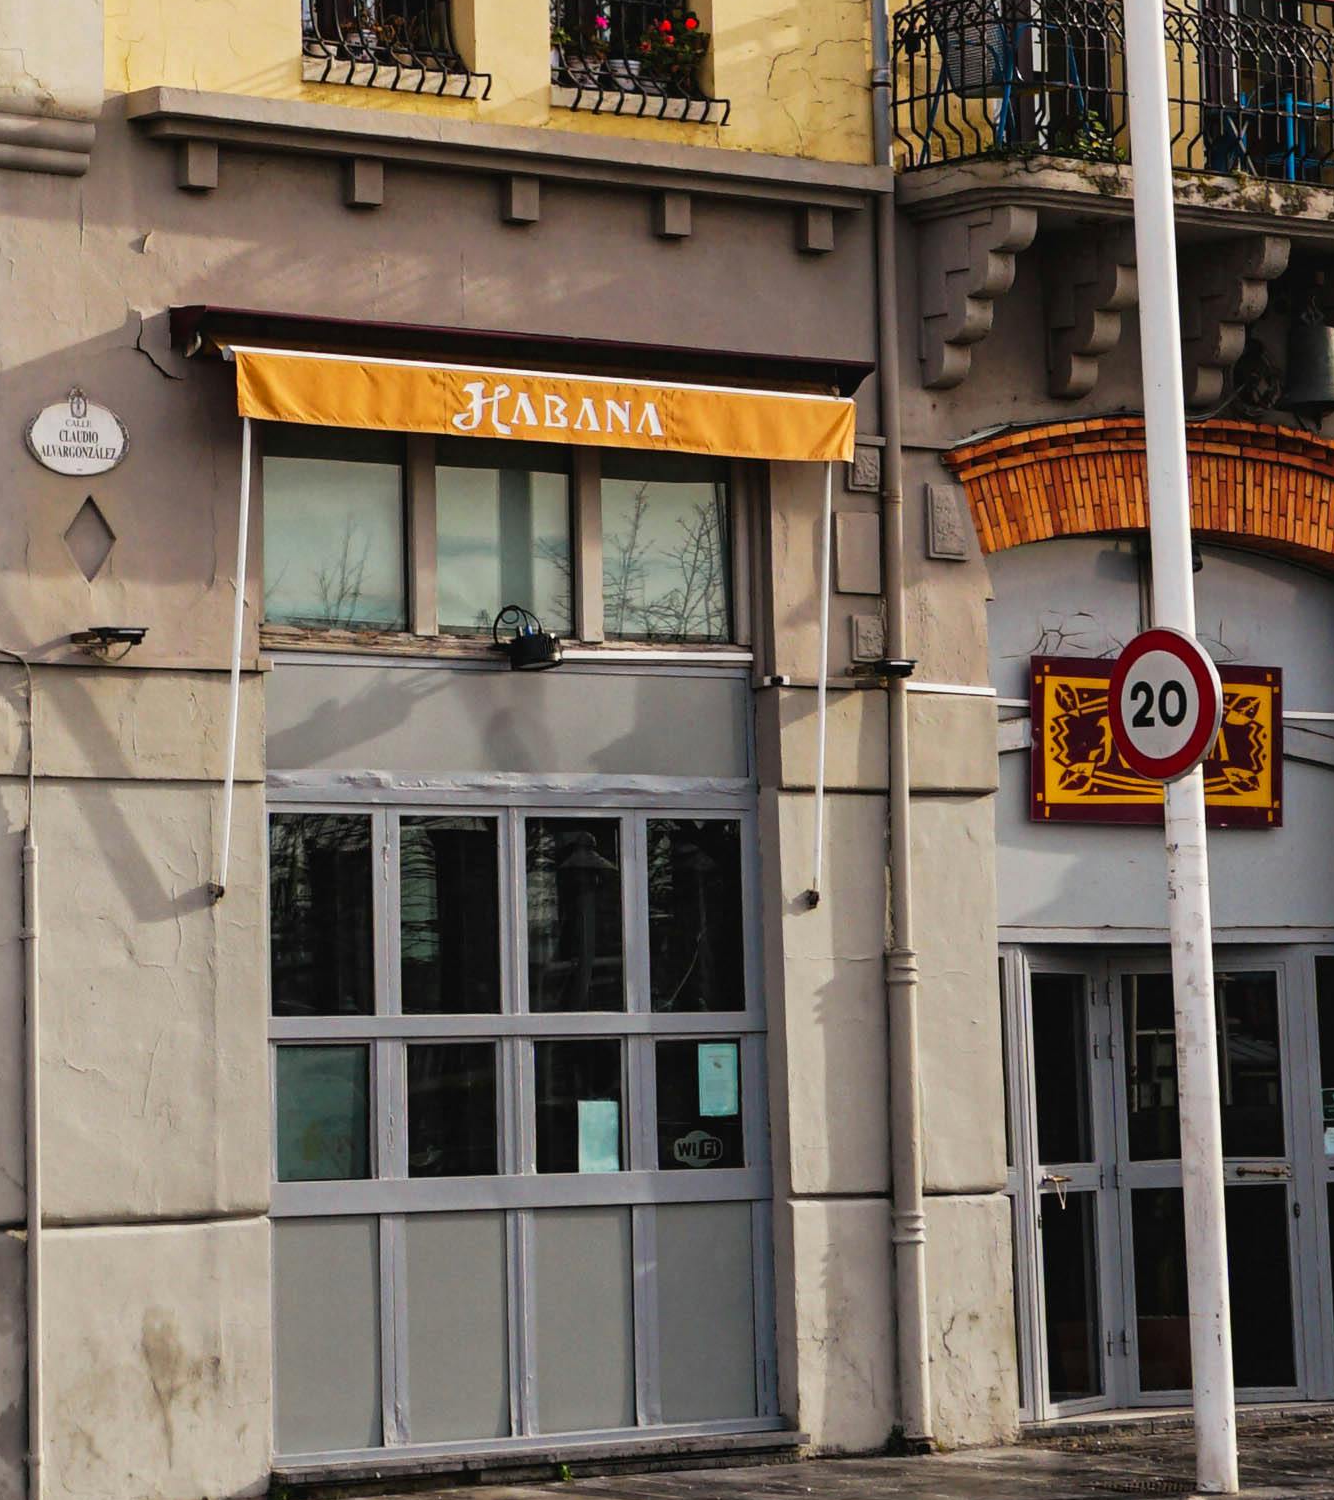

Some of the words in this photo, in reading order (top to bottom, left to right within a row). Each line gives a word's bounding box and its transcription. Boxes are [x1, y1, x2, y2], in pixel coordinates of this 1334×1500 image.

[452, 381, 664, 436] HABANA
[65, 419, 92, 428] CALLE
[59, 429, 99, 444] CLAUDIO
[41, 443, 116, 460] ALVARGONZÁLEZ
[1130, 680, 1187, 728] 20
